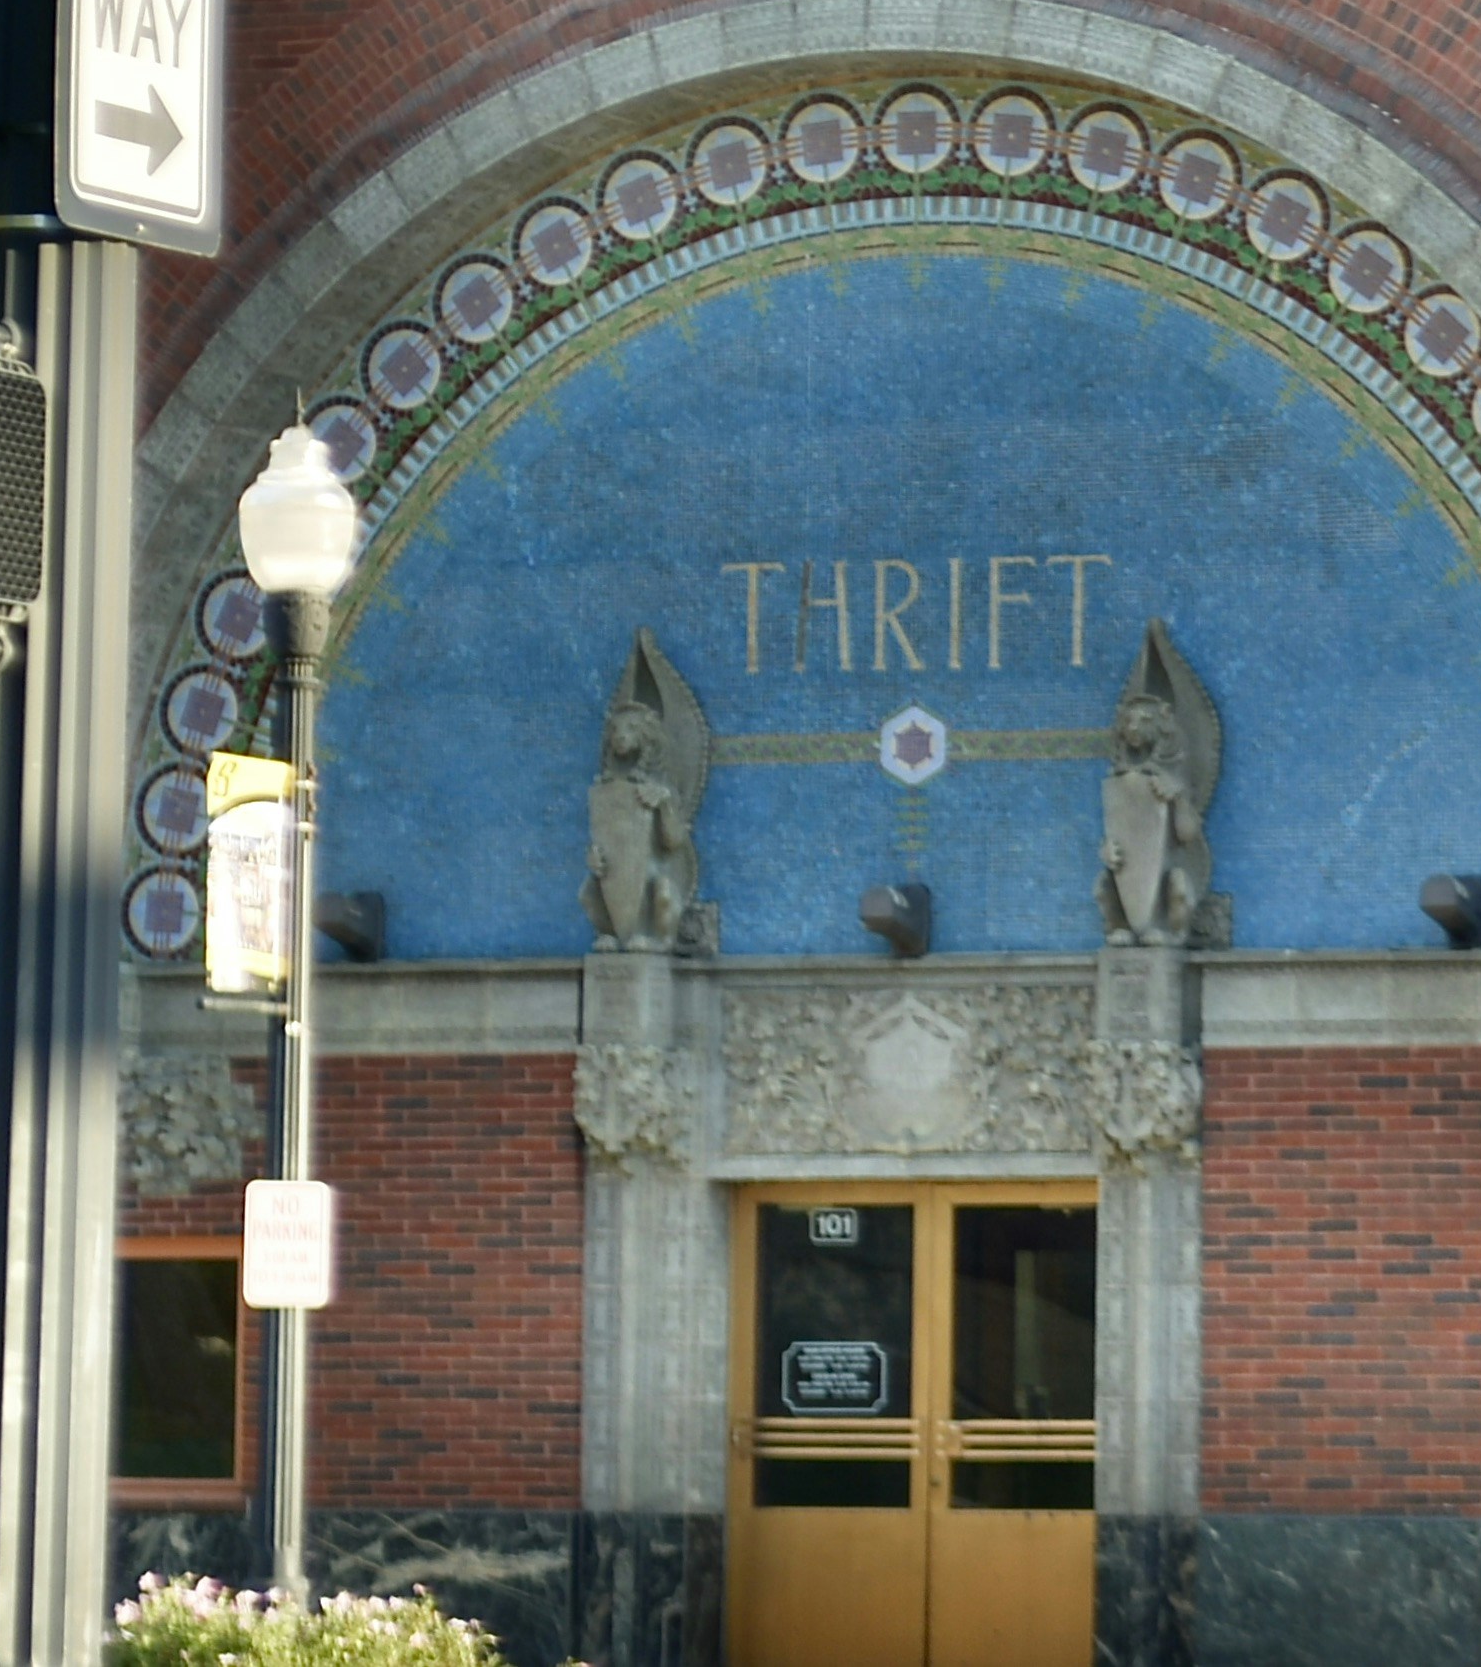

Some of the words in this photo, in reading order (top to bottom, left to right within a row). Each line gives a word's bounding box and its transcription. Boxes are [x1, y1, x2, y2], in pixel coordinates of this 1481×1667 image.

[720, 554, 1113, 675] THRIFT
[272, 1195, 300, 1216] NO
[252, 1219, 318, 1242] PARKING
[817, 1214, 852, 1236] 101
